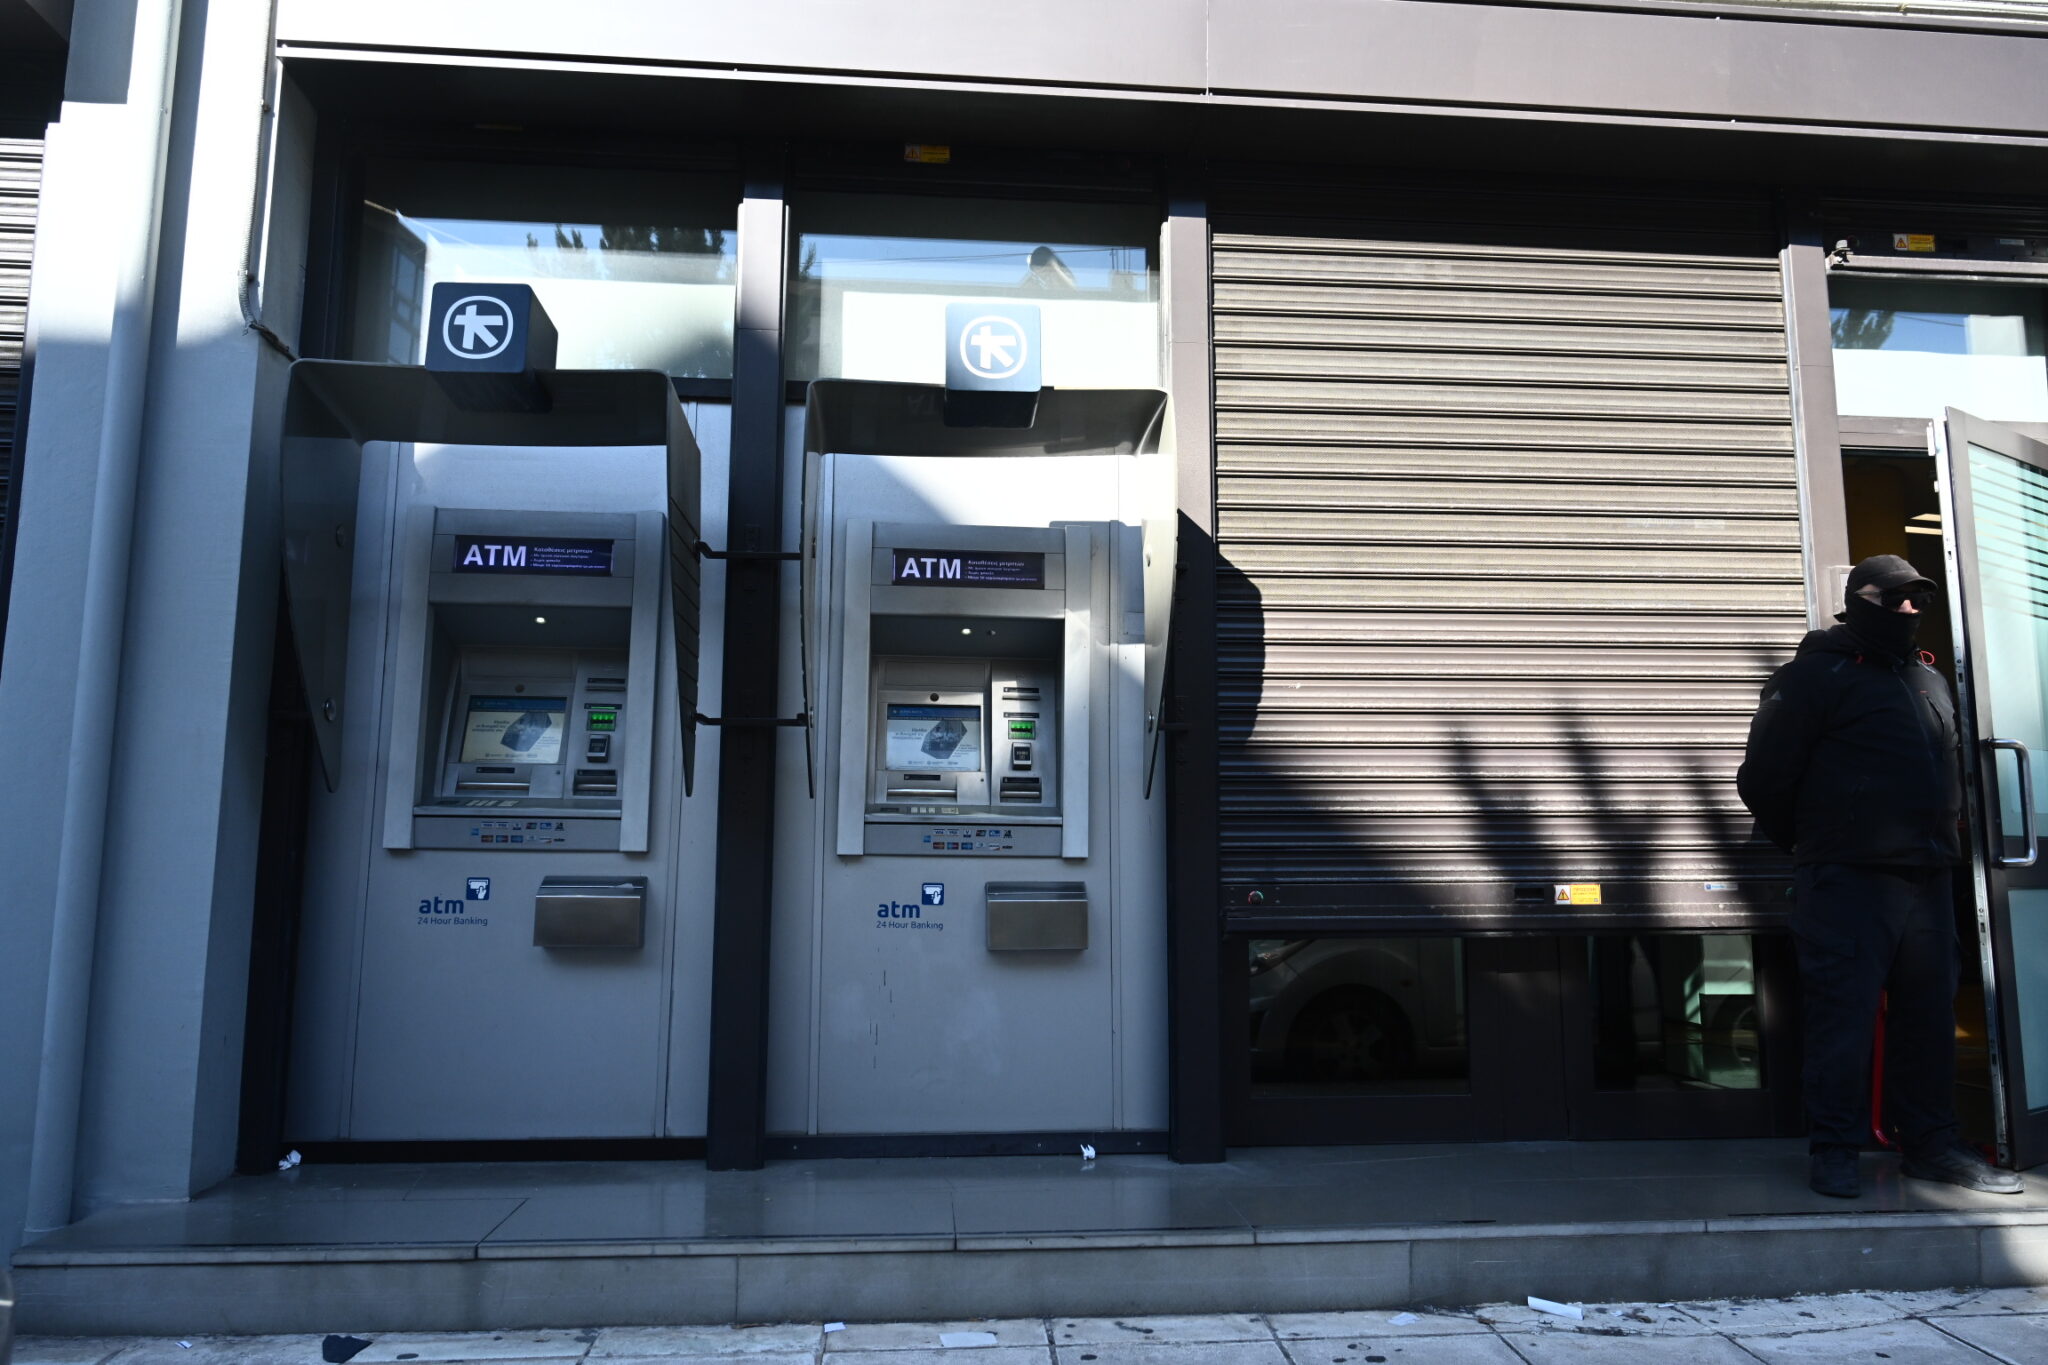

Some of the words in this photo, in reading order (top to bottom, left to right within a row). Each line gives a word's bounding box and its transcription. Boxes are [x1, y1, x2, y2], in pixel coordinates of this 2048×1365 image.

[463, 544, 527, 567] ATM
[902, 557, 961, 579] ATM
[419, 896, 464, 914] atm
[877, 901, 921, 918] atm
[417, 917, 428, 925] 24
[430, 917, 452, 925] Hour
[454, 916, 488, 926] Banking
[876, 920, 887, 929] 24
[888, 921, 909, 929] Hour
[911, 920, 944, 932] Banking
